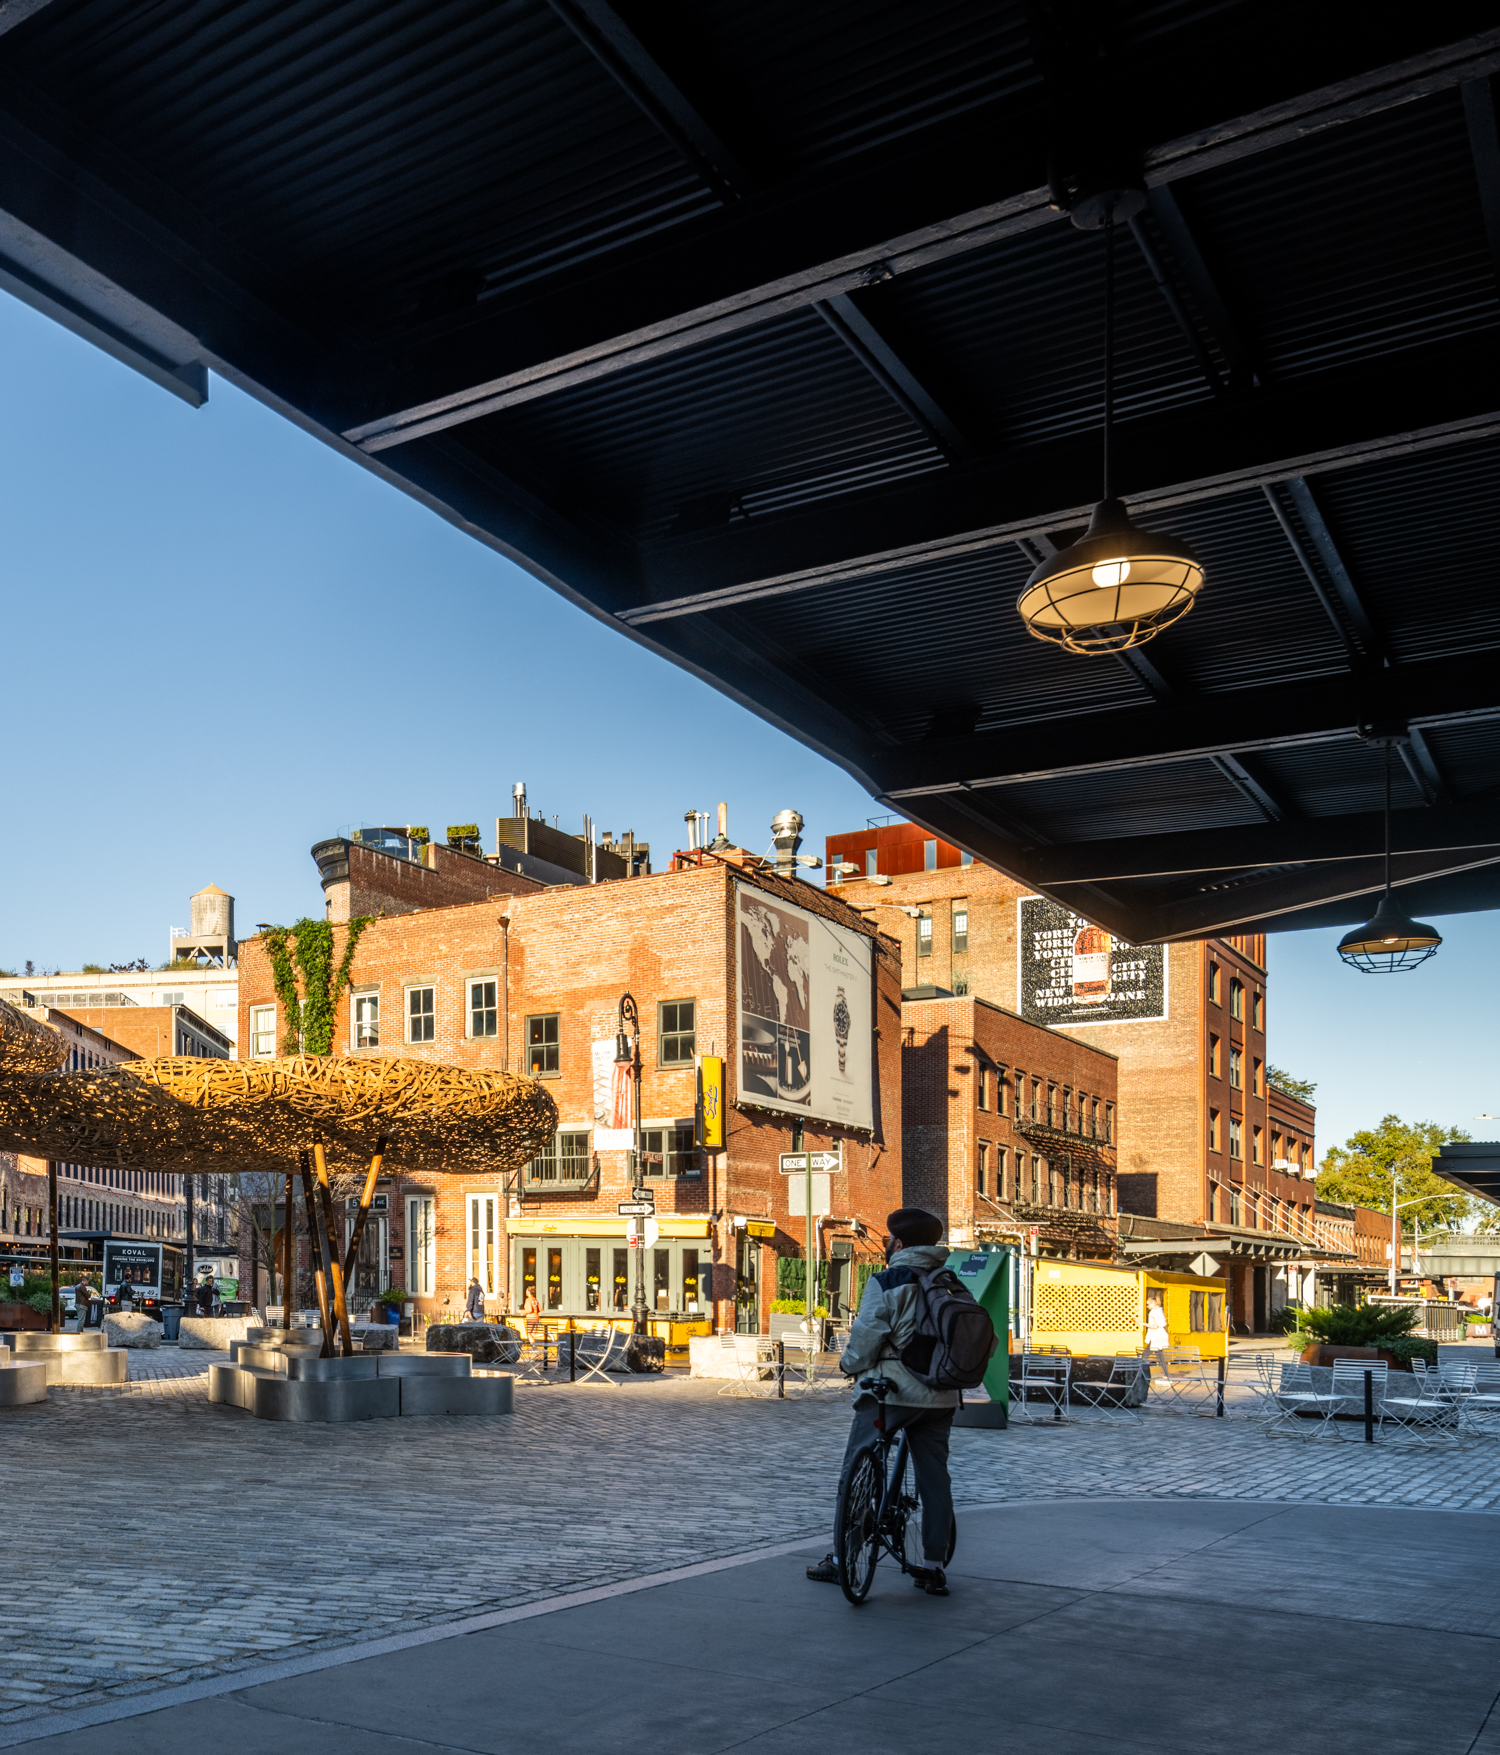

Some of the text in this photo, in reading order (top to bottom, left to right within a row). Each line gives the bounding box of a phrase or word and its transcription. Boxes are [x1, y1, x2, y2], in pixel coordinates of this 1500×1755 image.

[832, 953, 849, 967] ROLEX
[1050, 957, 1073, 968] CIT
[1050, 967, 1073, 978] CIT
[1050, 977, 1073, 987] CIT
[785, 1158, 831, 1168] ONE WAY
[122, 1248, 147, 1256] KOVAL
[971, 1254, 988, 1262] Design
[1474, 1324, 1487, 1334] M
